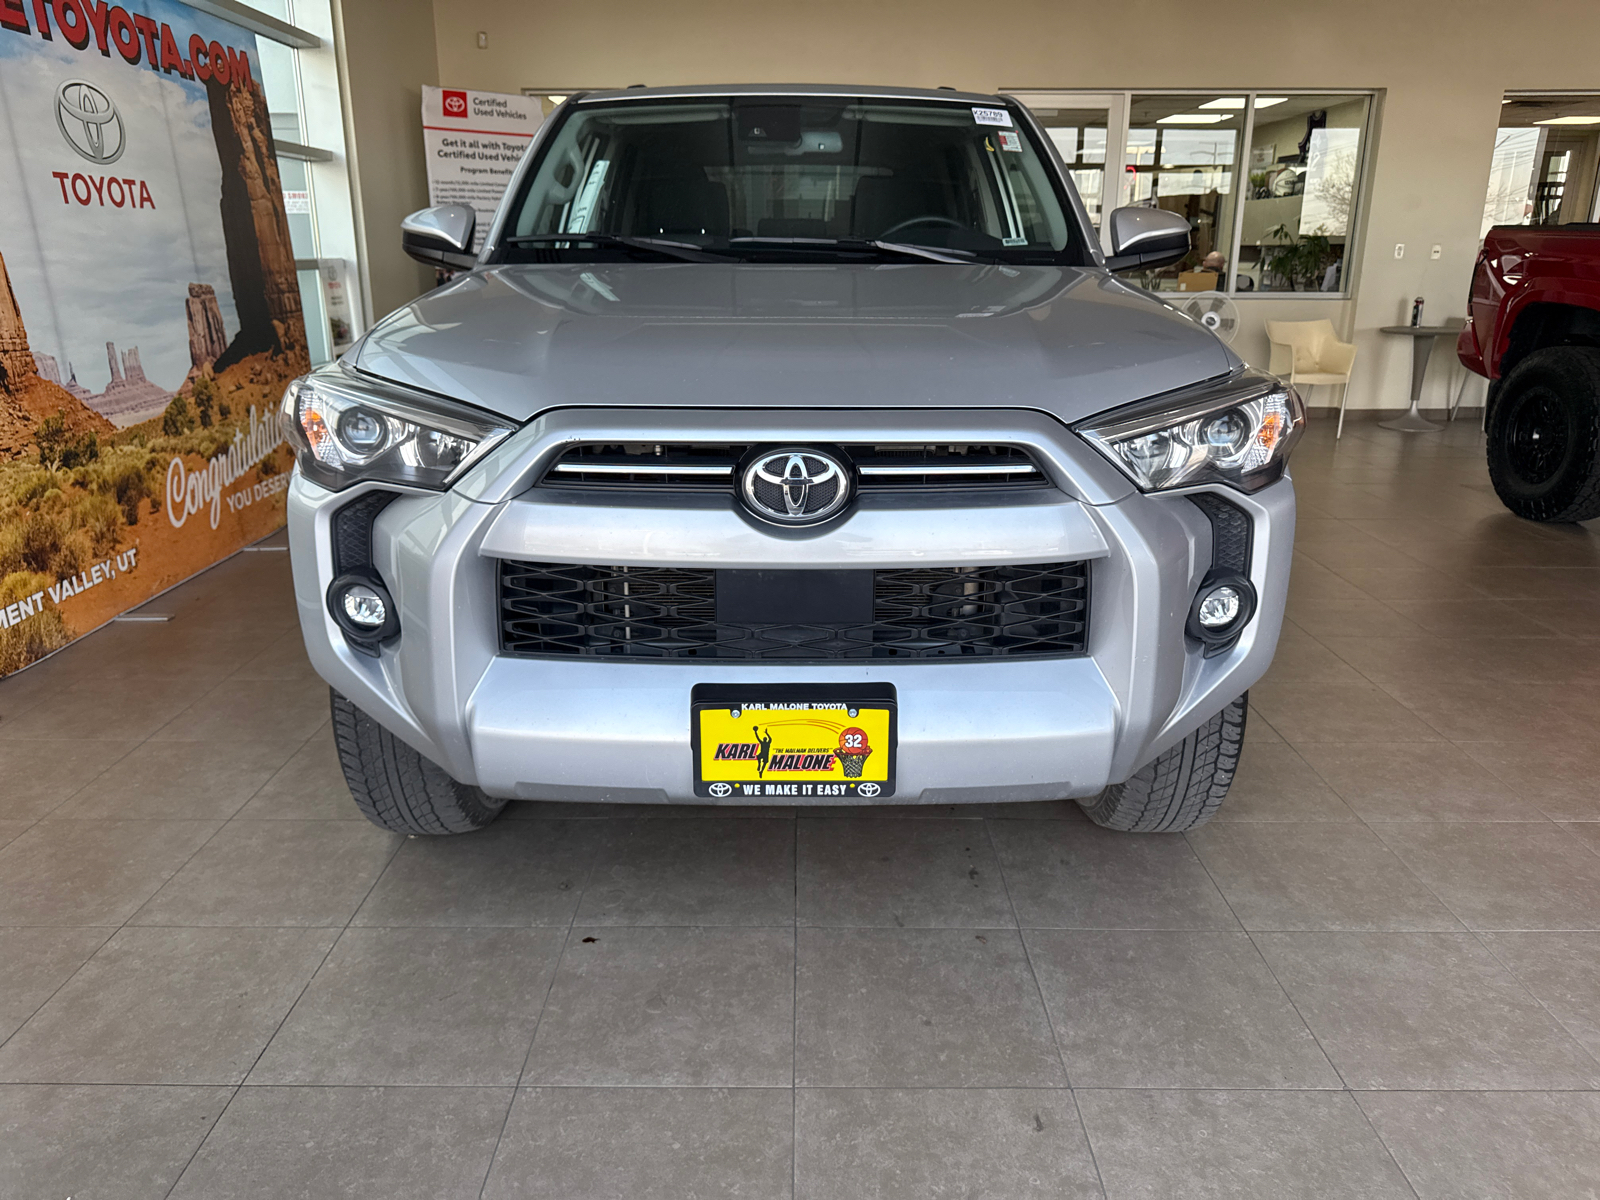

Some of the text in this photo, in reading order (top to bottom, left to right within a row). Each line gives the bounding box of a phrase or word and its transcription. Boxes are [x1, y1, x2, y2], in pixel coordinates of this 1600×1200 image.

[473, 97, 507, 108] Certified
[473, 108, 527, 120] Used Vehicles
[442, 138, 459, 148] Get
[460, 139, 467, 148] it
[468, 140, 480, 149] all
[481, 141, 501, 151] with
[437, 150, 476, 160] Certified
[478, 152, 499, 161] Used
[460, 166, 488, 176] Program
[52, 171, 156, 210] TOYOTA
[226, 489, 251, 513] YOU
[48, 562, 117, 605] VALLEY,
[117, 548, 137, 573] UT
[742, 703, 847, 711] KARL MALONE TOYOTA
[844, 734, 862, 748] 32
[713, 743, 759, 761] KARL
[767, 753, 836, 772] MALONE
[743, 784, 847, 796] WE MAKE IT EASY
